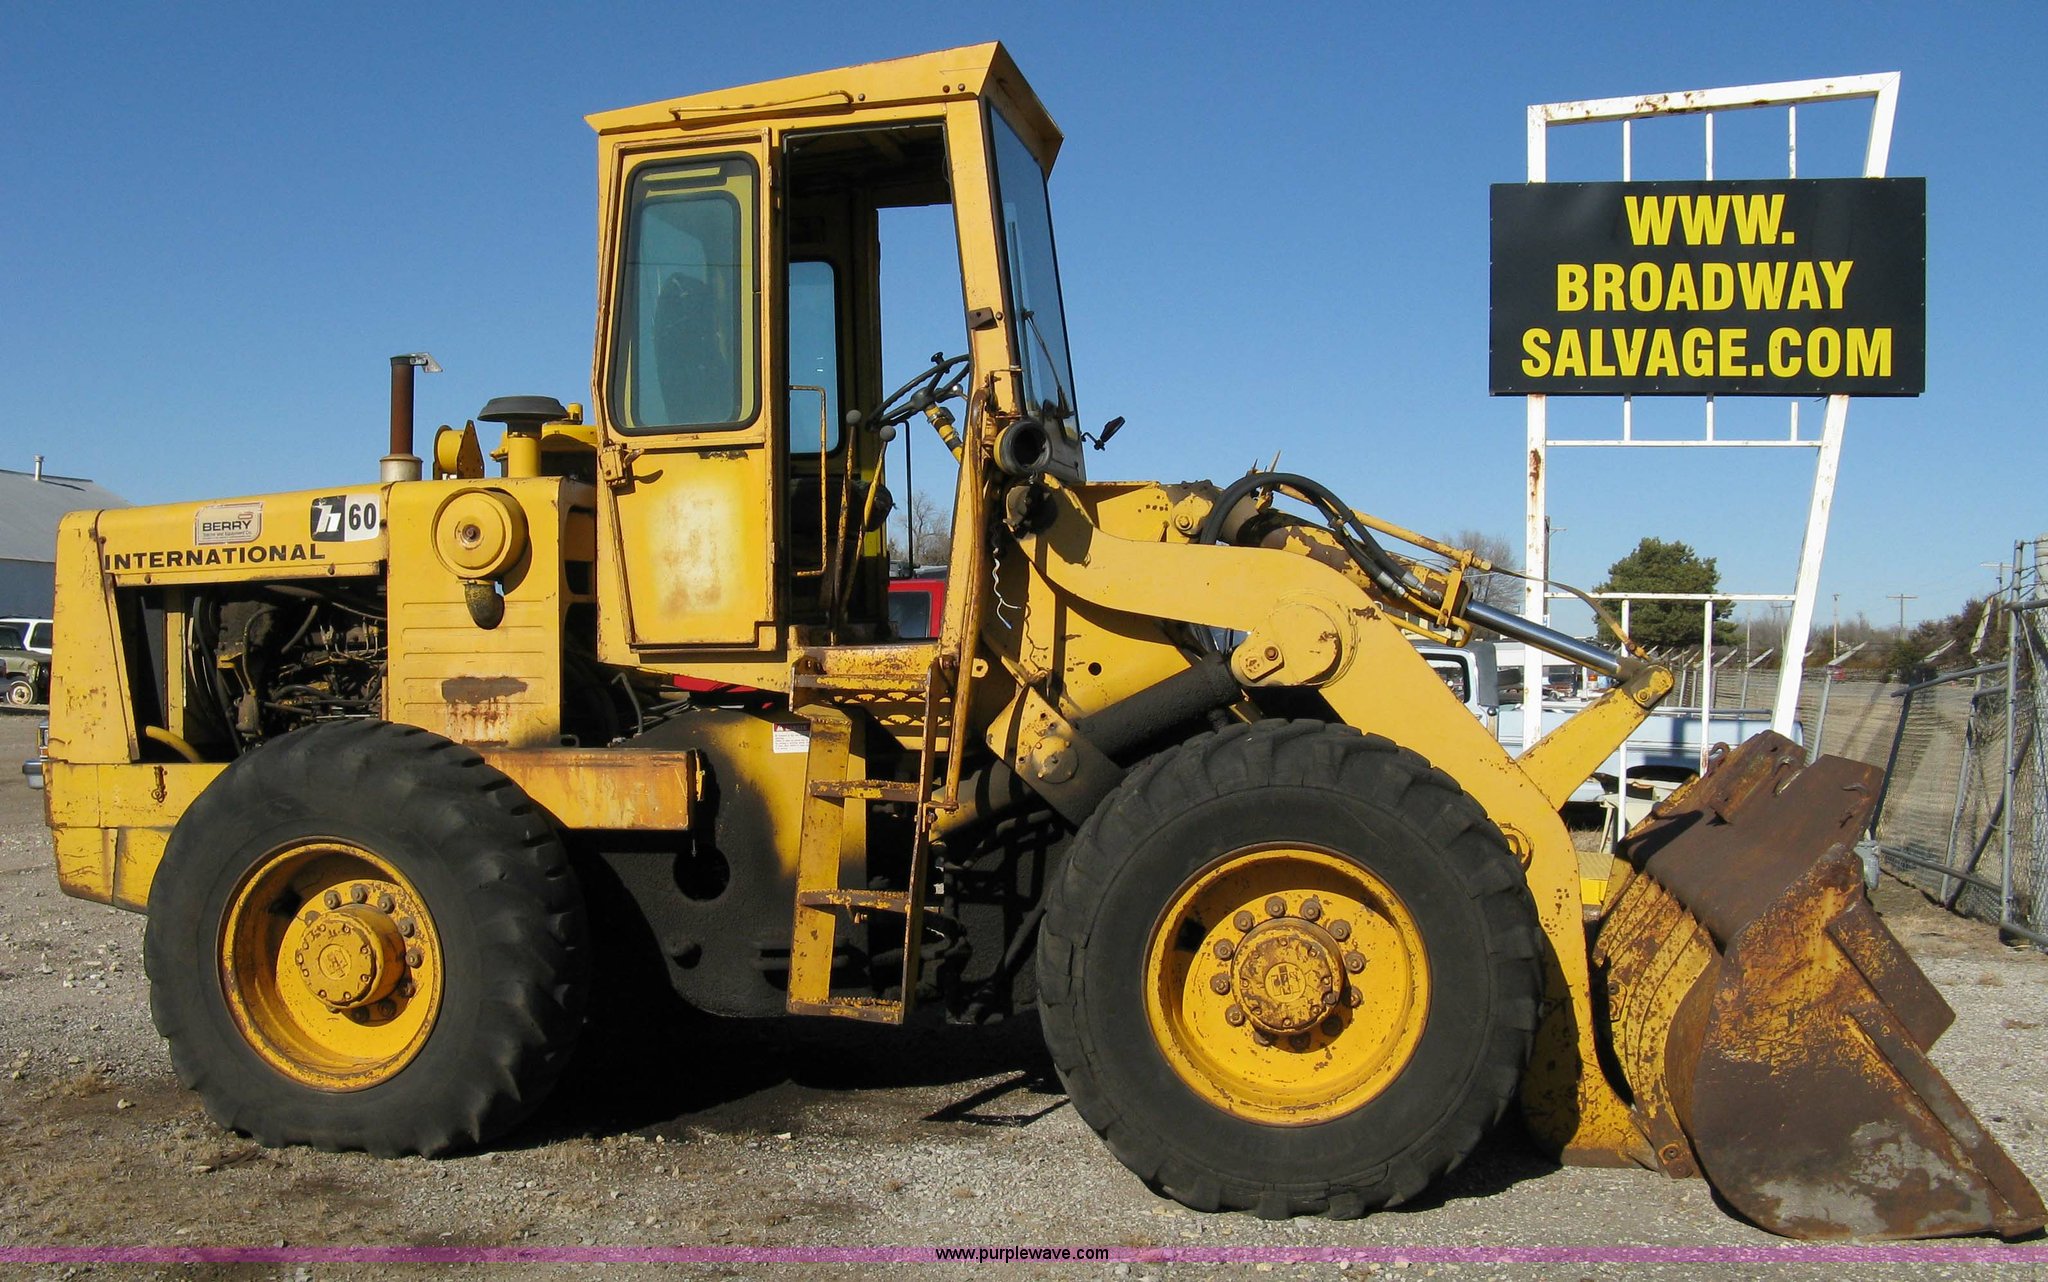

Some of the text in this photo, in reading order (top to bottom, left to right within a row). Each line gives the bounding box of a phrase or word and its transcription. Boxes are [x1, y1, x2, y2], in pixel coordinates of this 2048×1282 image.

[1625, 194, 1795, 245] WWW.
[1557, 260, 1853, 311] BROADWAY
[1521, 327, 1892, 377] SALVAGE.COM
[202, 520, 252, 532] BERRY
[349, 503, 377, 531] 60
[105, 543, 326, 571] INTERNATIONAL
